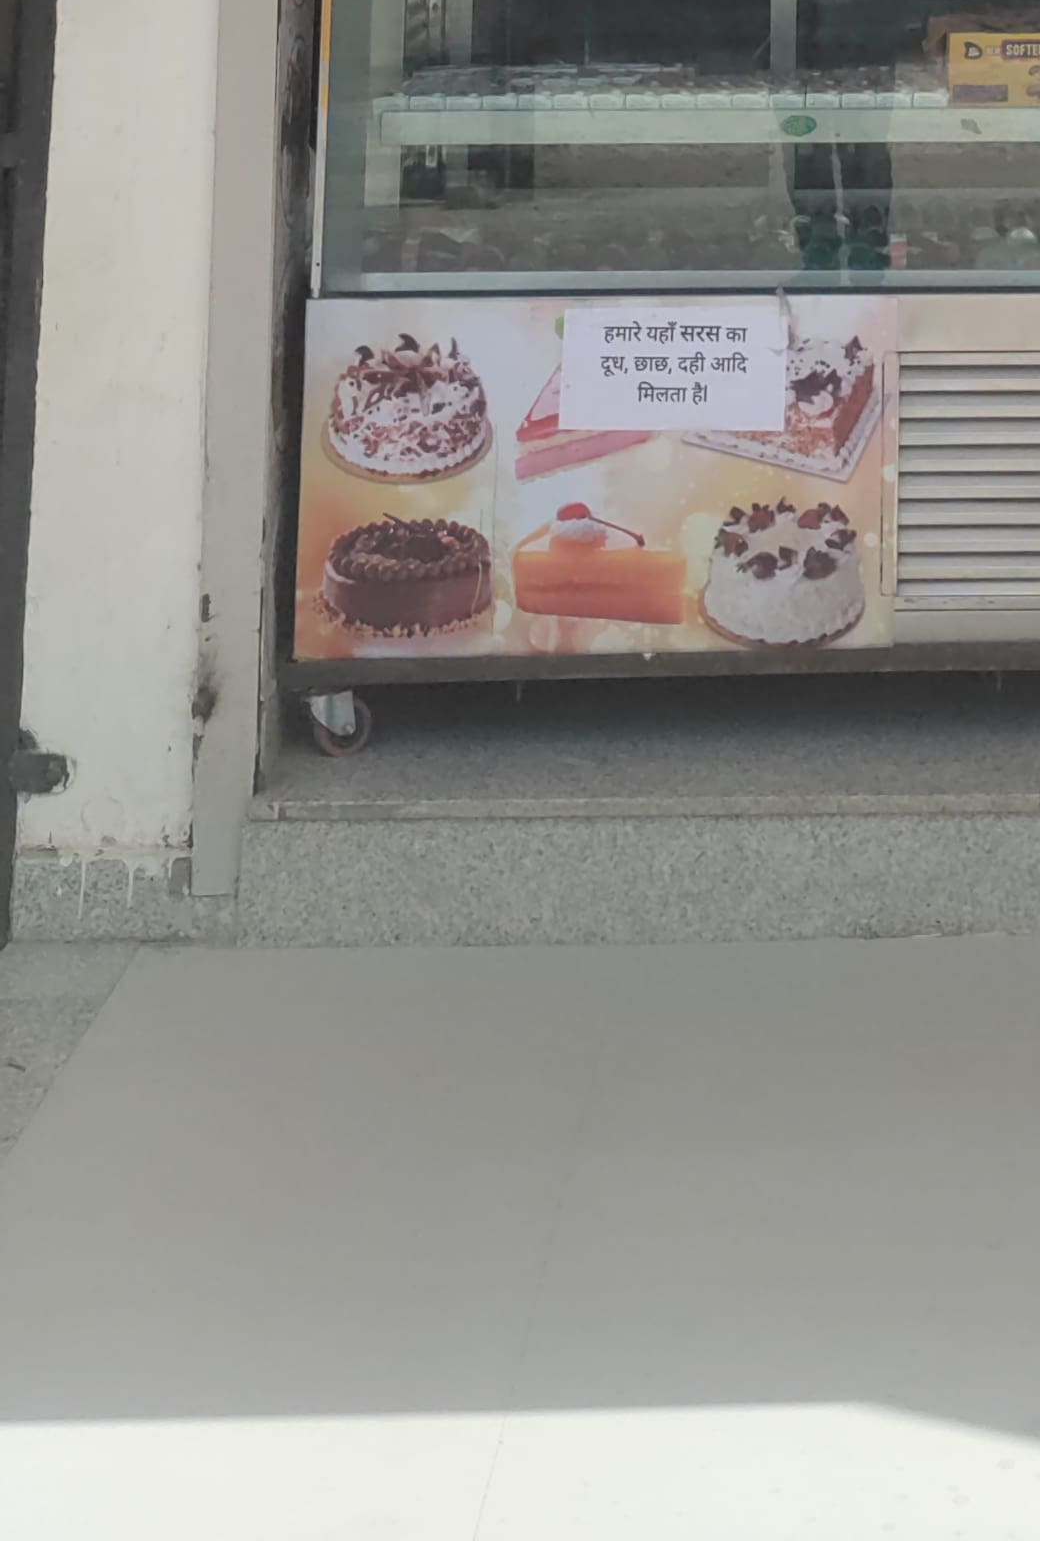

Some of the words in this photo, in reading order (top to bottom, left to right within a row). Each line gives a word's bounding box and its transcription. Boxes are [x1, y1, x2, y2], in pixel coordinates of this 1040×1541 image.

[604, 321, 642, 343] हमारे
[646, 321, 676, 344] यहाँ
[680, 325, 721, 342] सरस
[726, 326, 748, 343] का
[601, 356, 628, 377] दूध,
[634, 357, 672, 375] छाछ,
[678, 352, 705, 374] दही
[711, 352, 748, 373] आदि
[637, 382, 686, 402] मिलता
